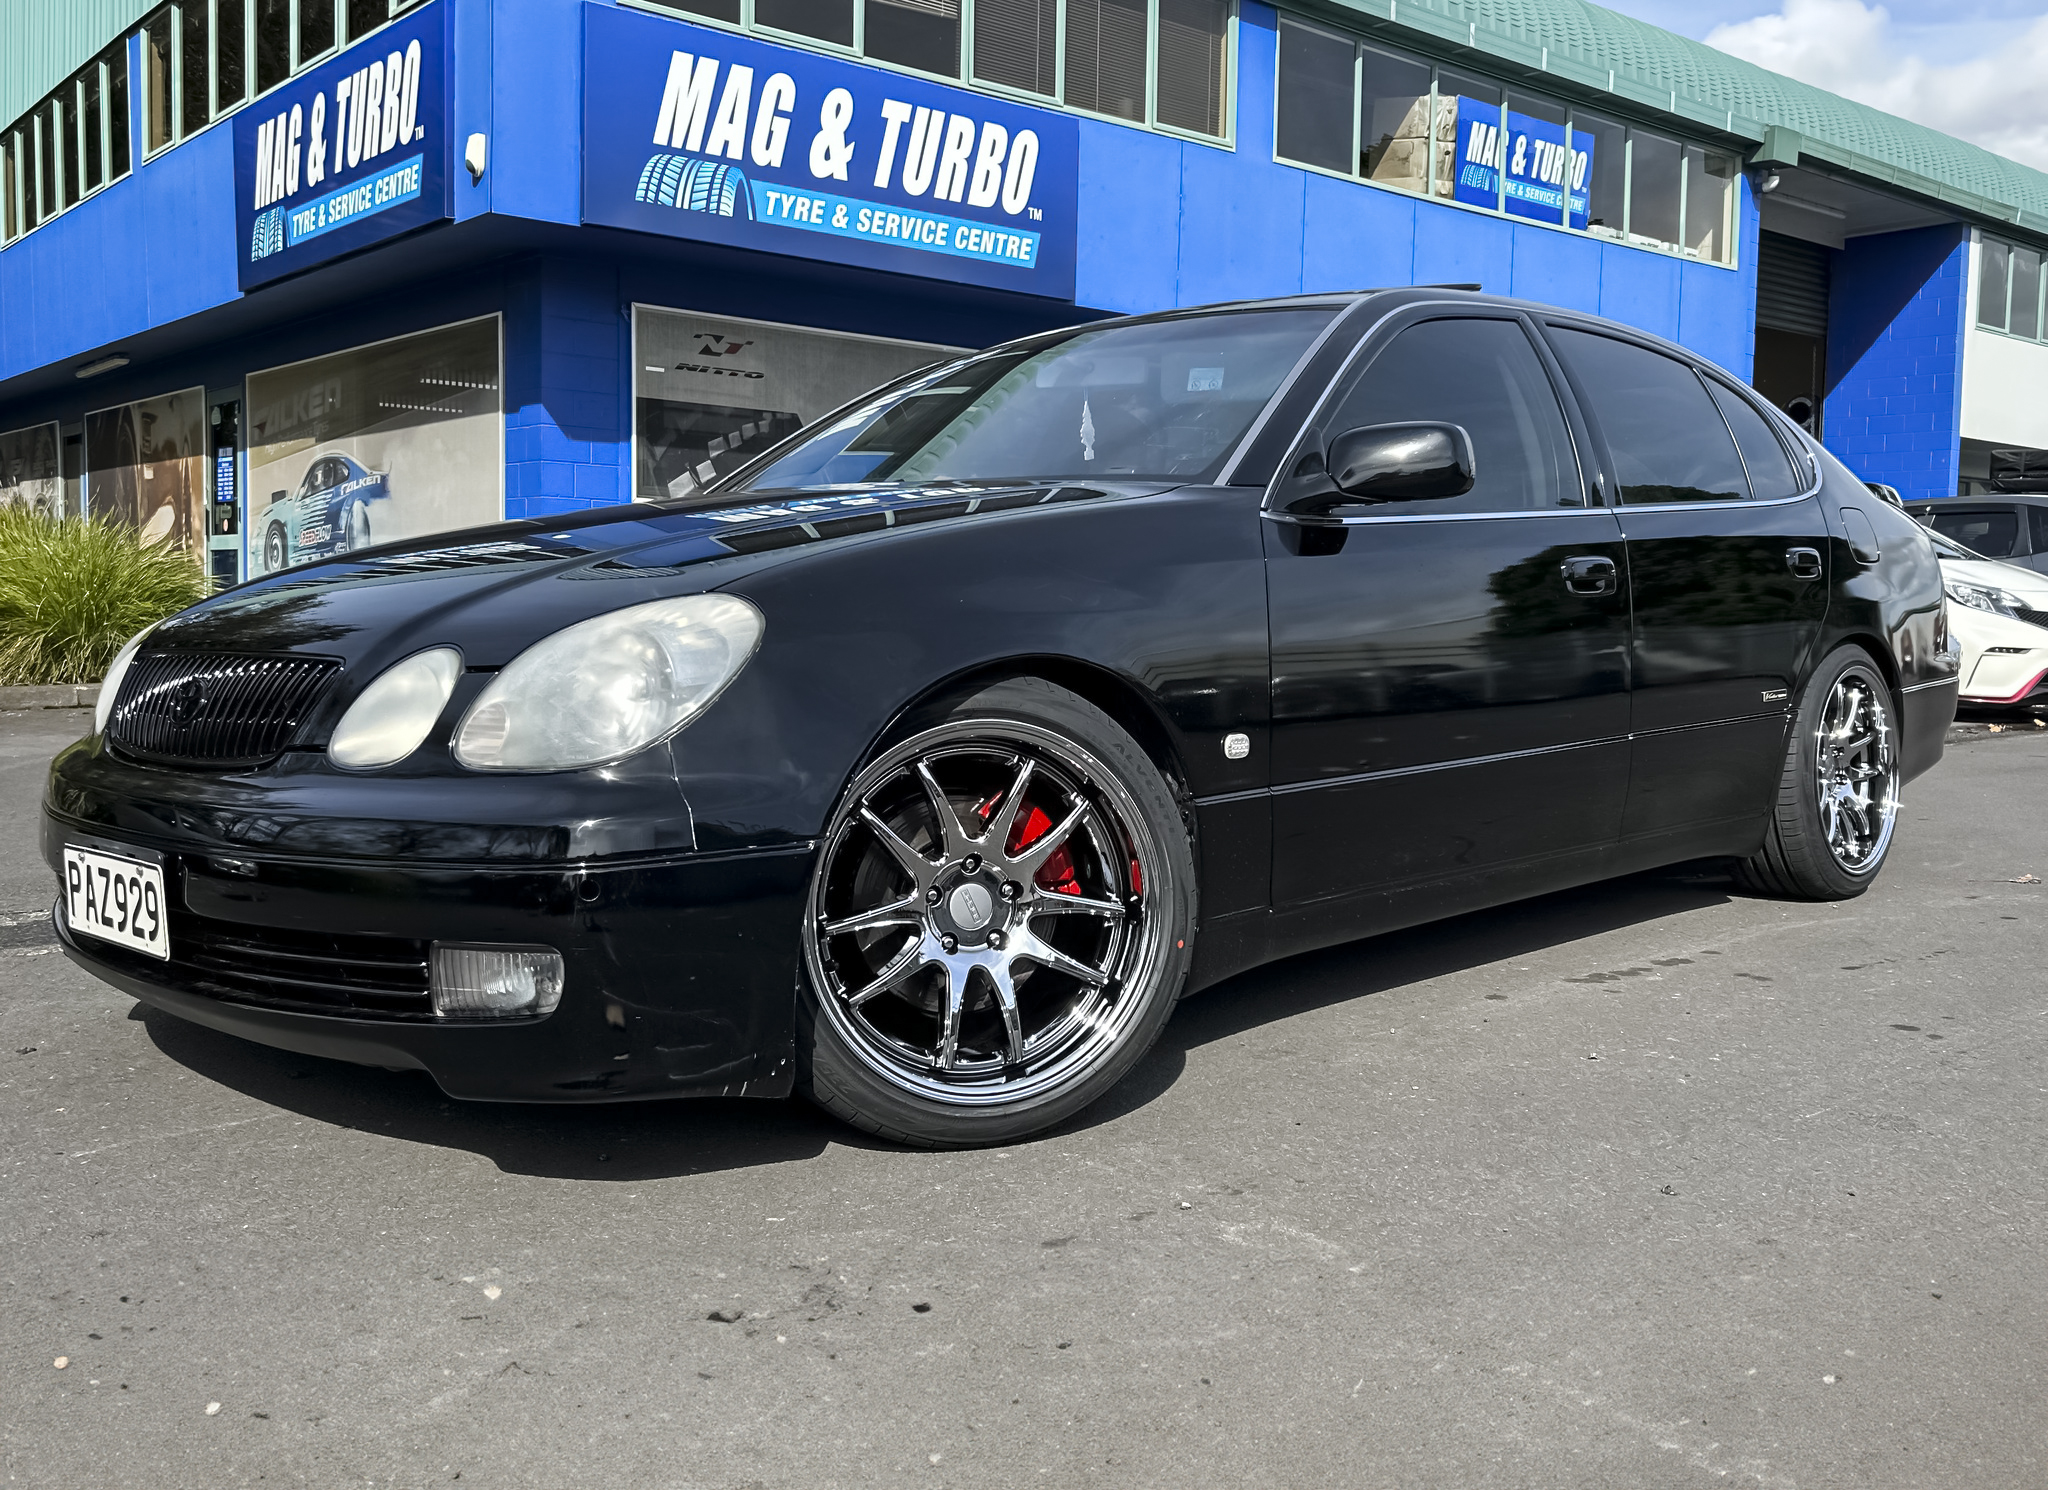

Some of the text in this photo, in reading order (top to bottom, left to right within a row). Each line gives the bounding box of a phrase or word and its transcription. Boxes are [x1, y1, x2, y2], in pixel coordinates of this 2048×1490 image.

[254, 103, 303, 211] MAG
[307, 91, 327, 188] &
[334, 38, 421, 175] TURBO
[652, 50, 797, 169] MAG
[808, 87, 856, 182] &
[873, 98, 1040, 216] TURBO
[1511, 134, 1528, 176] &
[292, 163, 420, 239] TYRE & SERVICE CENTRE
[765, 190, 1034, 261] TYRE & SERVICE CENTRE
[1524, 186, 1556, 206] SERVICE
[1556, 194, 1584, 211] CTRE
[675, 362, 765, 379] NITTO
[340, 474, 381, 496] FALKEN
[67, 860, 160, 942] PAZ929
